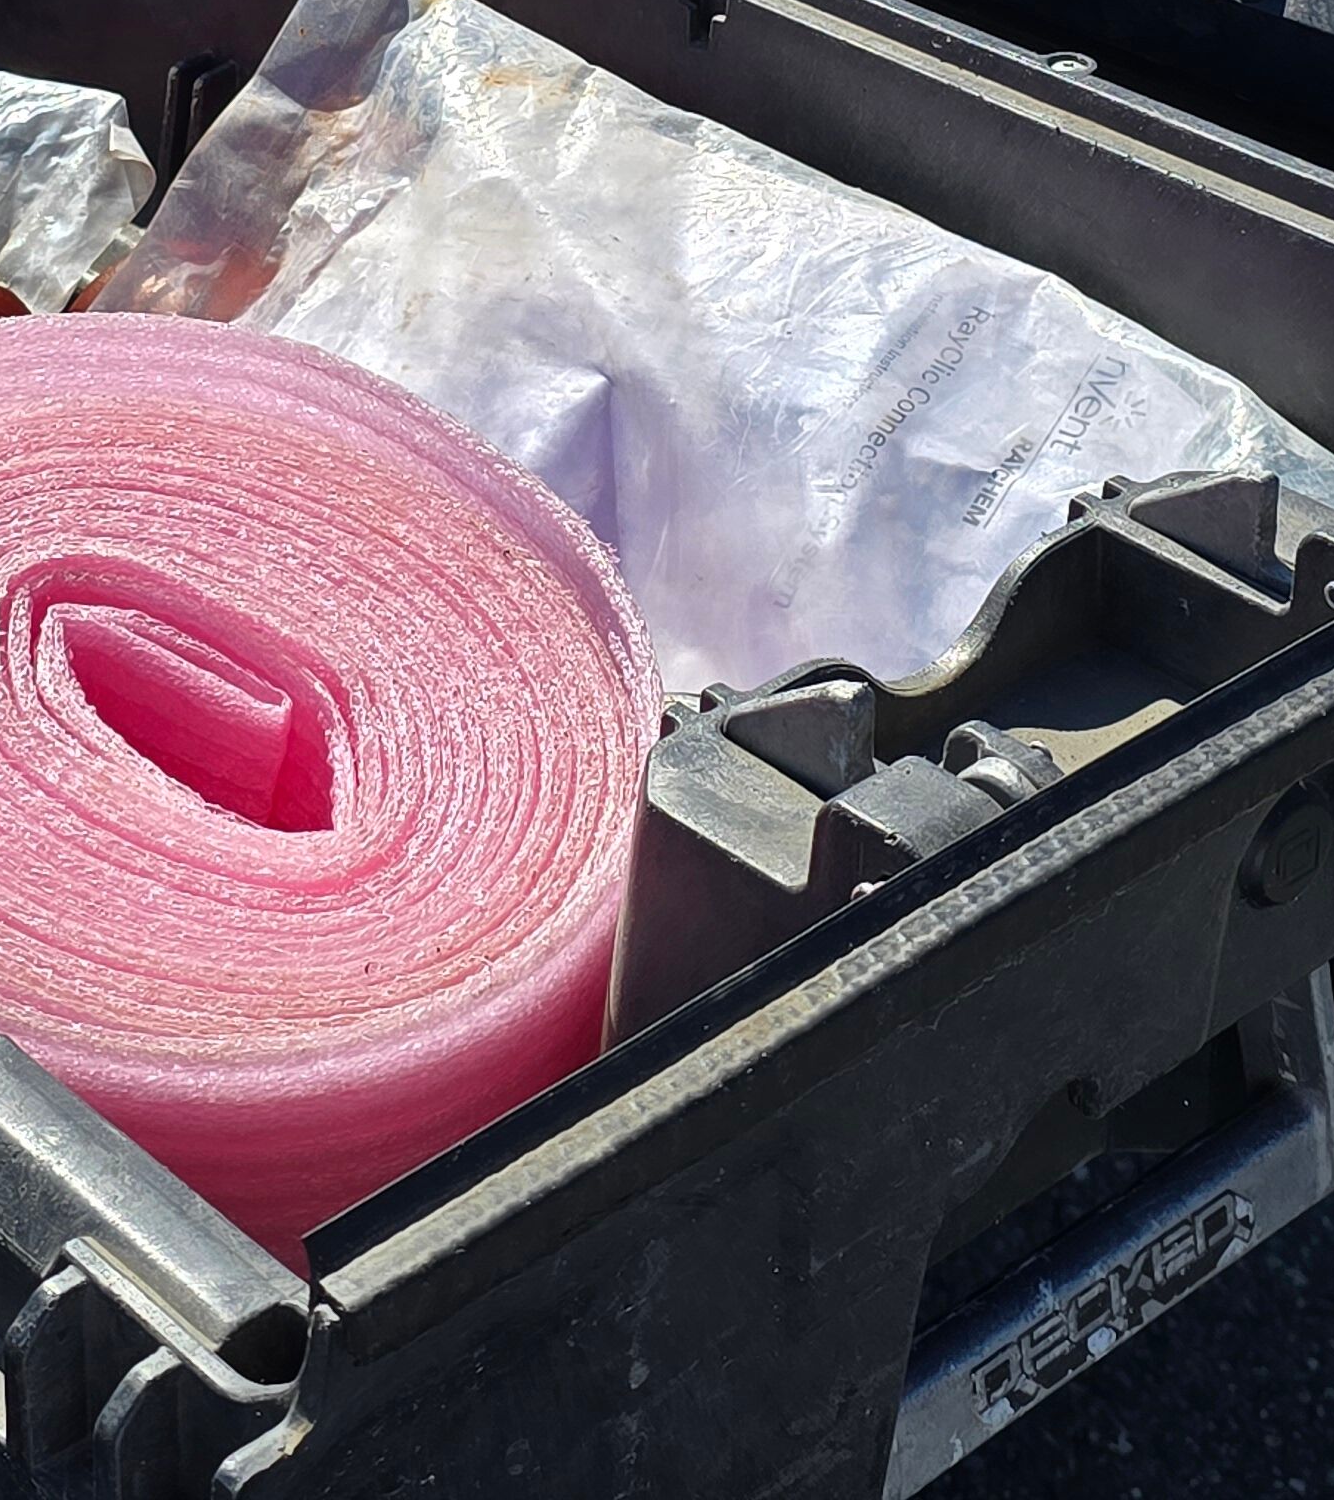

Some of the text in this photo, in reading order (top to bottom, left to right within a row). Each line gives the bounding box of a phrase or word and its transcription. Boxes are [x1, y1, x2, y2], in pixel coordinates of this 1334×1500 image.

[893, 292, 947, 350] Instation
[921, 304, 996, 386] RayClic
[830, 384, 931, 508] Connection
[961, 436, 1033, 527] RAYCHEM
[969, 1189, 1257, 1421] DECKED
